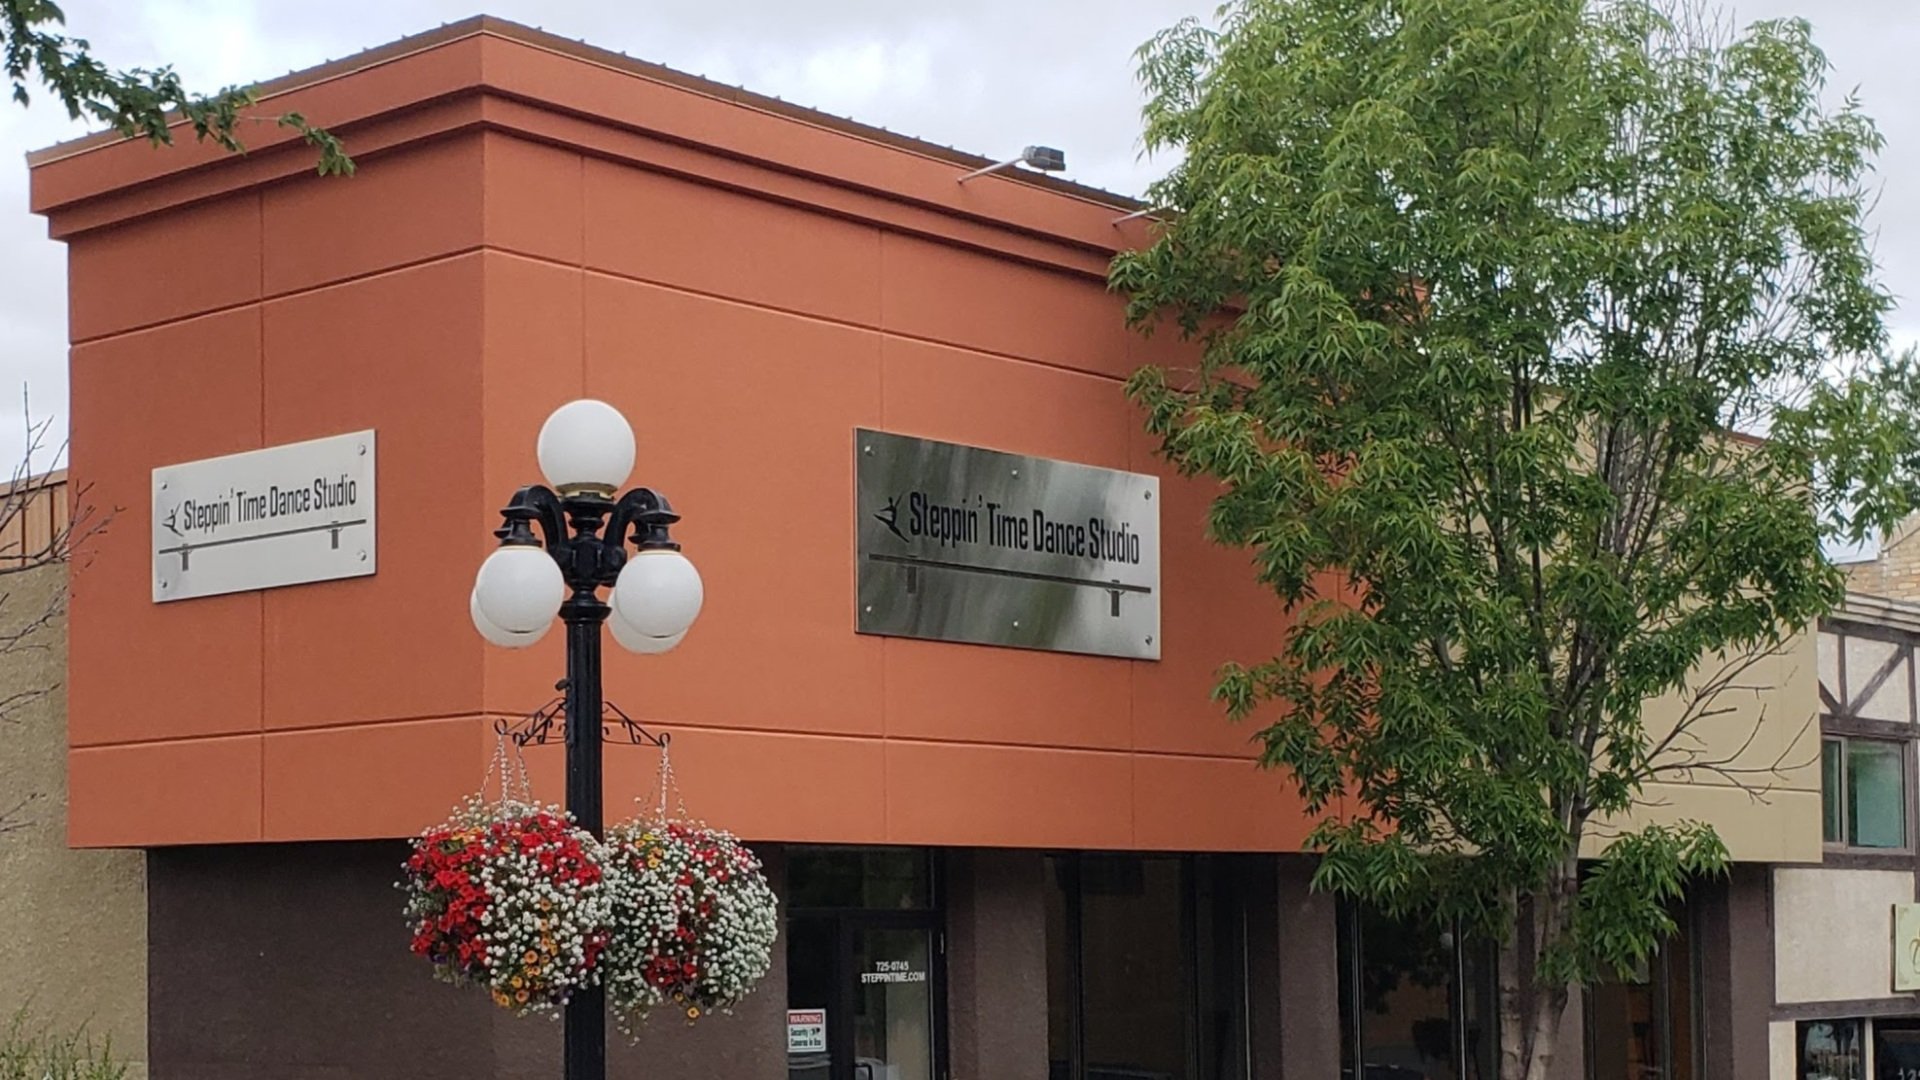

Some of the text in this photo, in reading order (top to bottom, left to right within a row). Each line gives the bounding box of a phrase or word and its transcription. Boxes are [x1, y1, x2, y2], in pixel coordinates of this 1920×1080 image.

[184, 473, 356, 535] Steppin' Time Dance Studio
[910, 491, 1140, 565] Steppin' Time Dance Studio
[875, 960, 909, 972] 725-0745
[789, 1014, 822, 1024] WARNING
